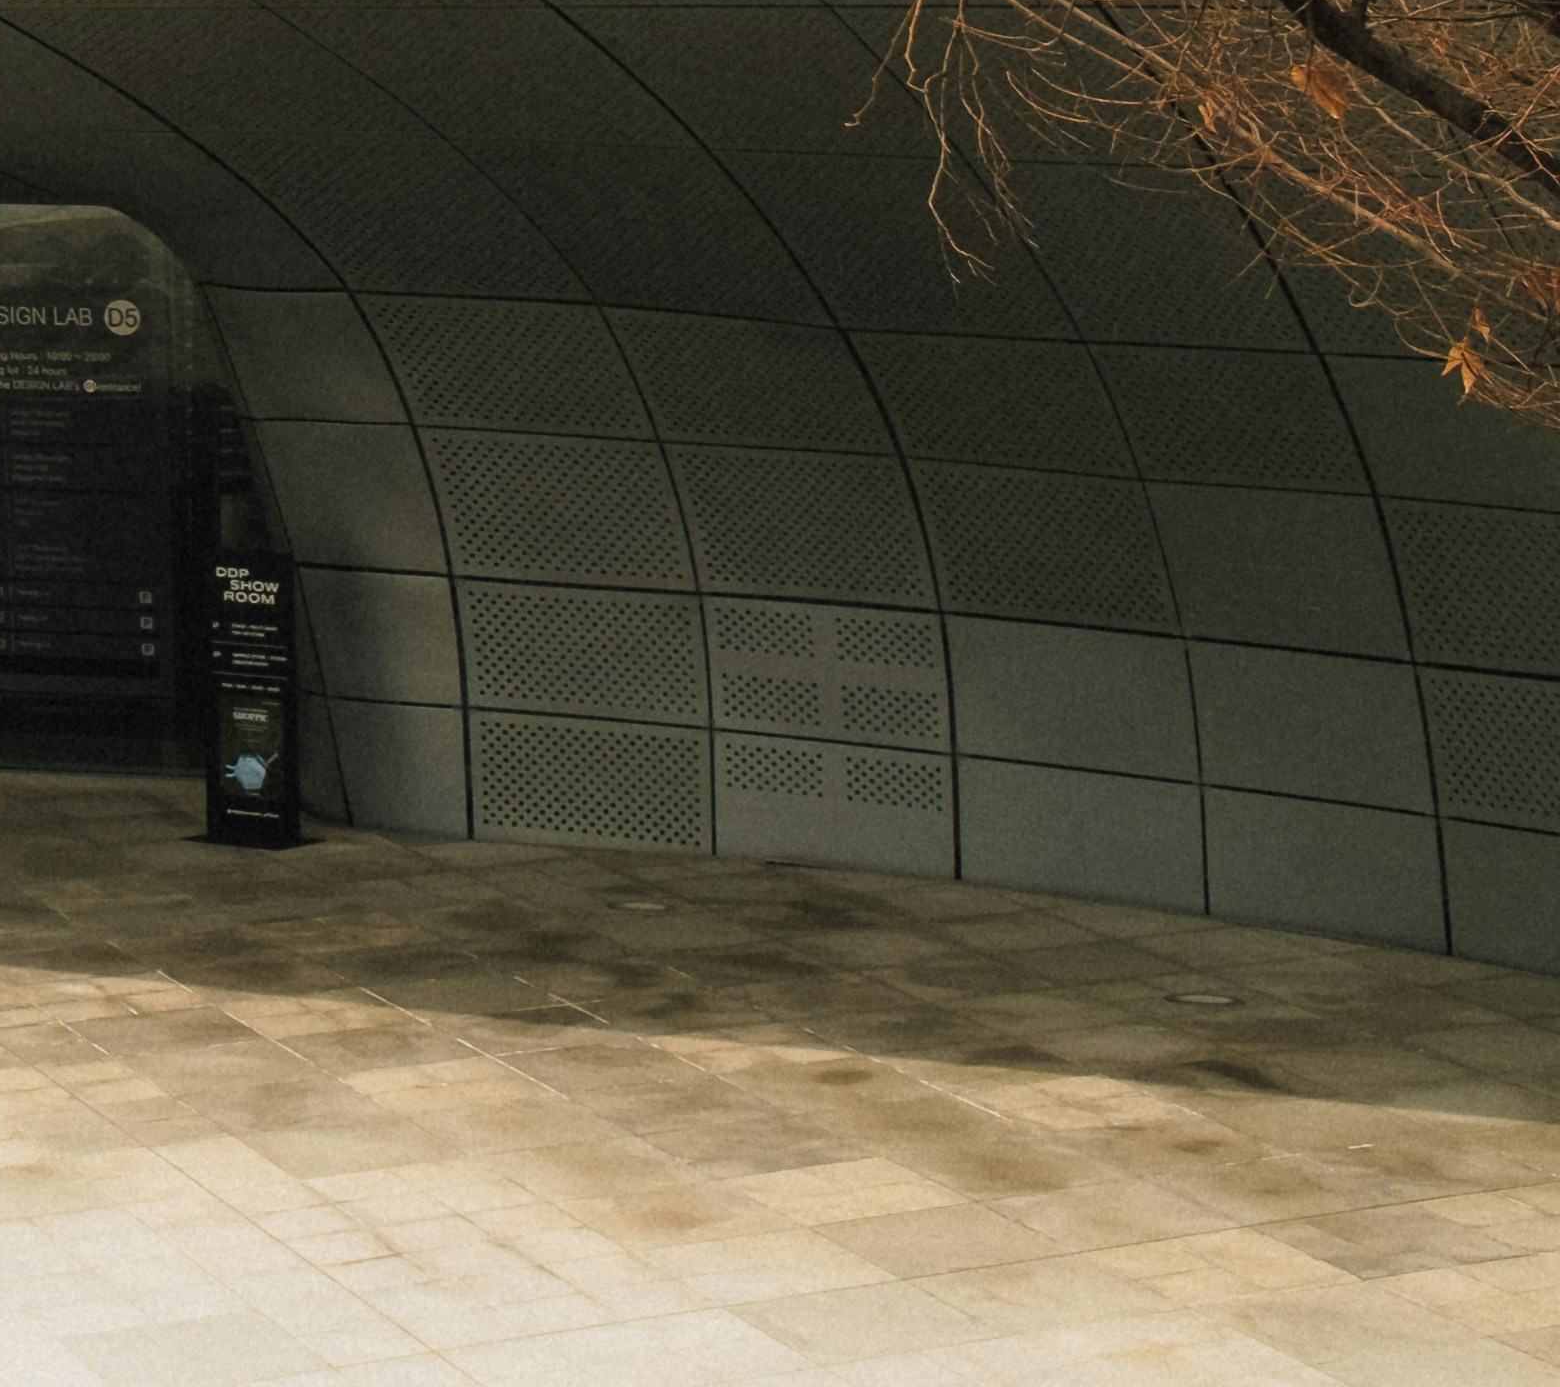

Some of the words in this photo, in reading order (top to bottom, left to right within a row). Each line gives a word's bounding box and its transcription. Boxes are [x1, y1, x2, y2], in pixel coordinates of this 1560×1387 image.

[53, 306, 93, 327] LAB
[107, 307, 139, 328] D5
[41, 365, 67, 376] hours
[13, 379, 50, 390] DESIGN
[216, 567, 249, 578] DDP
[230, 580, 279, 592] SHOW
[224, 591, 275, 604] ROOM
